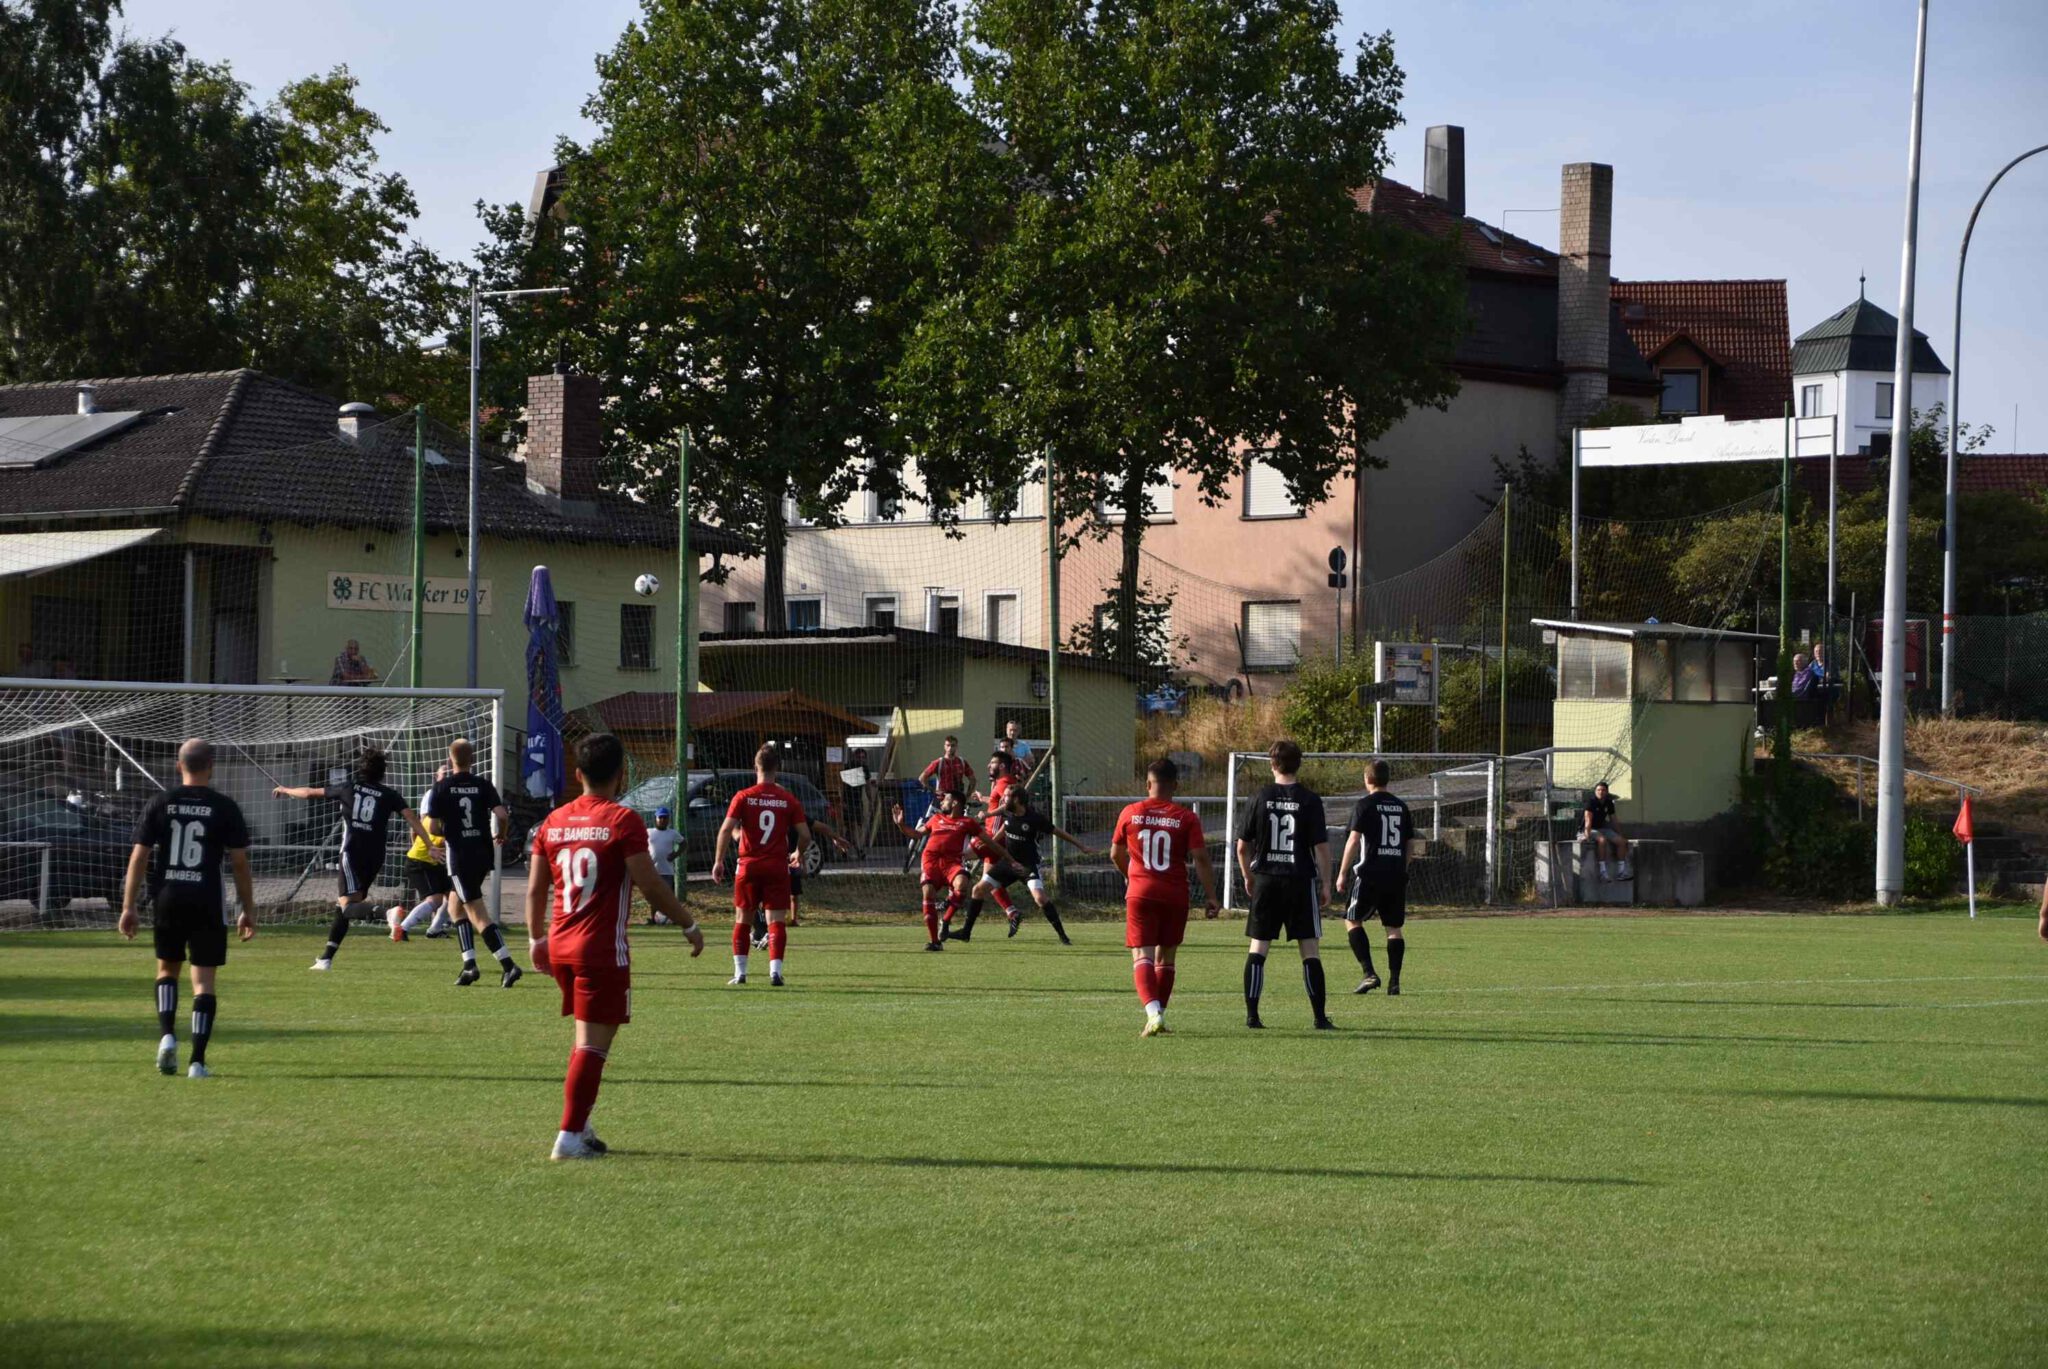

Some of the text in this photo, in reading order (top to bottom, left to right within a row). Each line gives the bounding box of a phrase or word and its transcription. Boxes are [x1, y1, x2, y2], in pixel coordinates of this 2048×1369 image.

[358, 580, 487, 605] FC Waker 197
[167, 804, 212, 816] FC WACKER
[352, 792, 376, 822] 18
[459, 796, 473, 829] 3
[747, 797, 788, 808] TSC BAMBERG
[1266, 800, 1300, 811] FC WACKER
[1376, 804, 1383, 812] FC
[547, 827, 611, 842] TSC BAMBERG
[759, 810, 775, 845] 9
[1131, 815, 1181, 829] TSC BAMBERG
[1269, 813, 1296, 851] 12
[1381, 814, 1401, 847] 15
[169, 819, 205, 868] 16
[1137, 828, 1171, 871] 10
[1267, 852, 1295, 864] BAMBERG
[556, 847, 598, 914] 19
